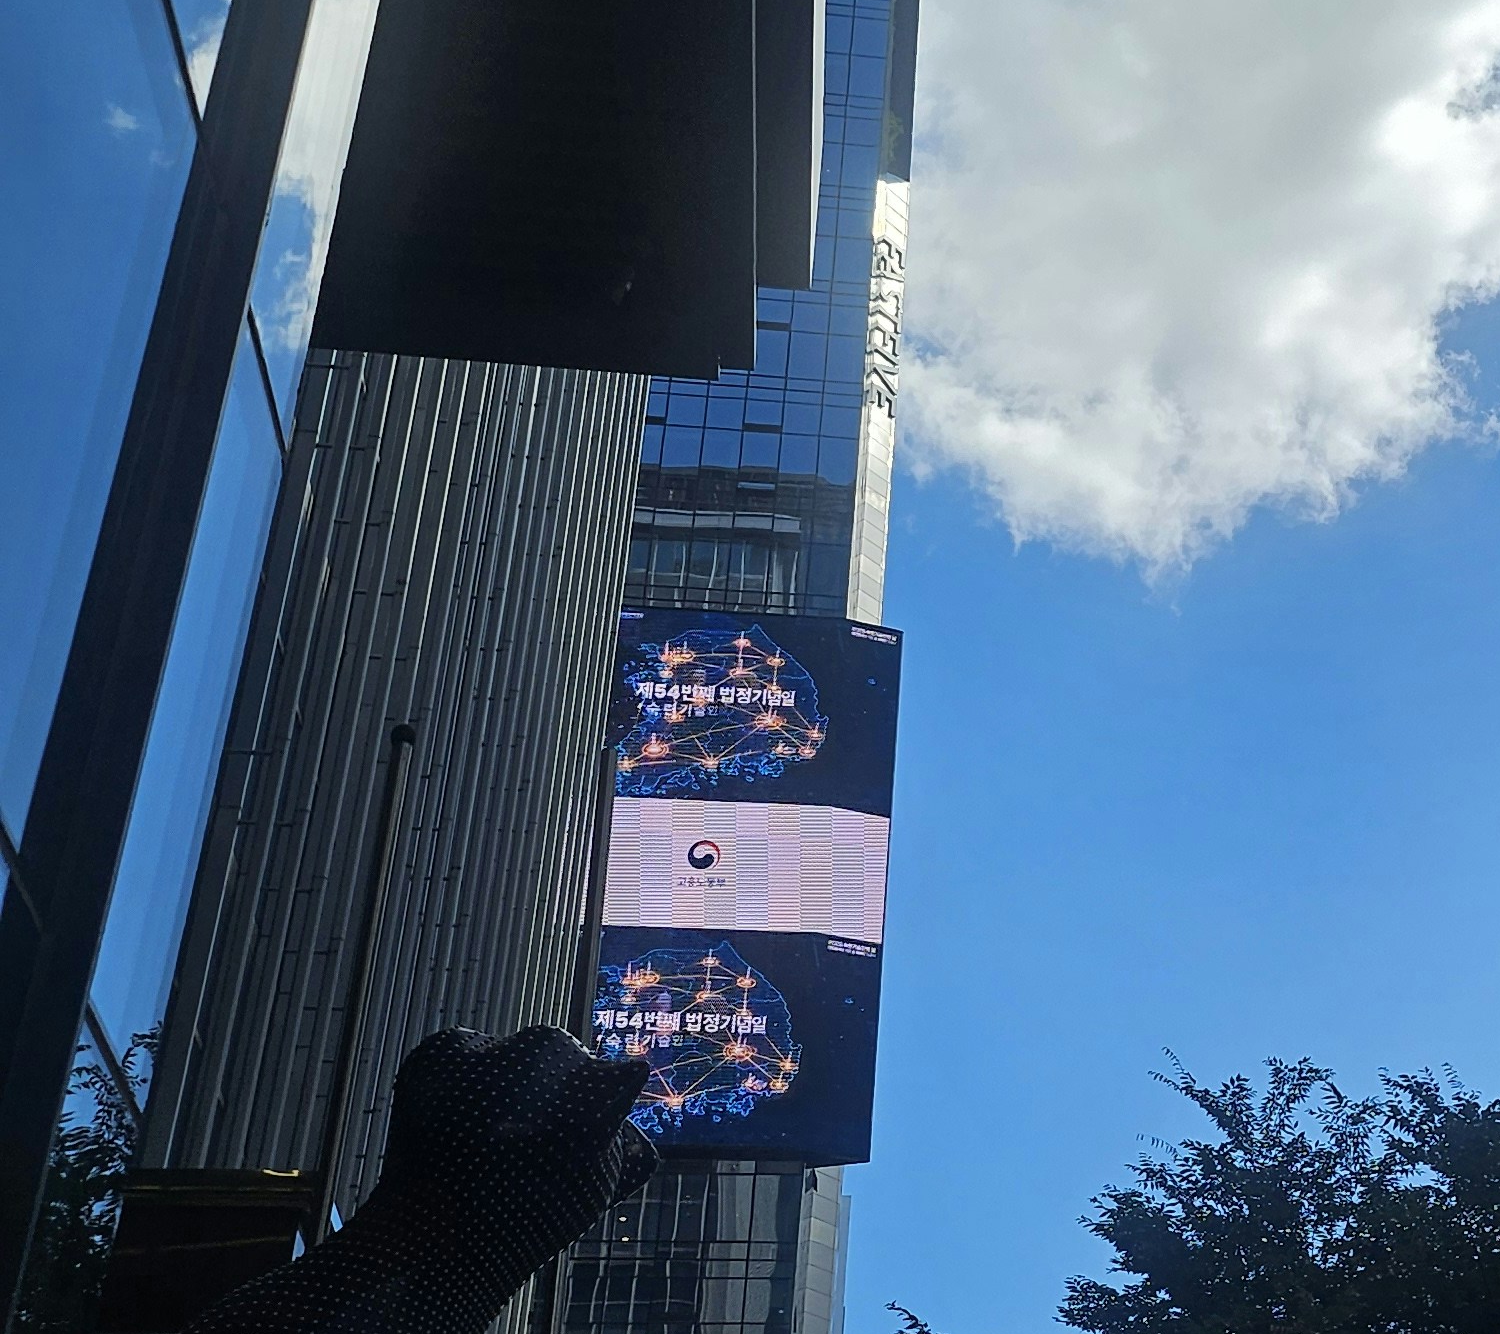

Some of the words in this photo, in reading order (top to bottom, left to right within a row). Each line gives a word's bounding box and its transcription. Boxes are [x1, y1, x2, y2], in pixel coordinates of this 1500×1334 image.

[636, 680, 715, 703] 제54번째
[719, 684, 797, 708] 법정기념일
[595, 1008, 681, 1032] 제54번째
[684, 1012, 768, 1036] 법정기념일
